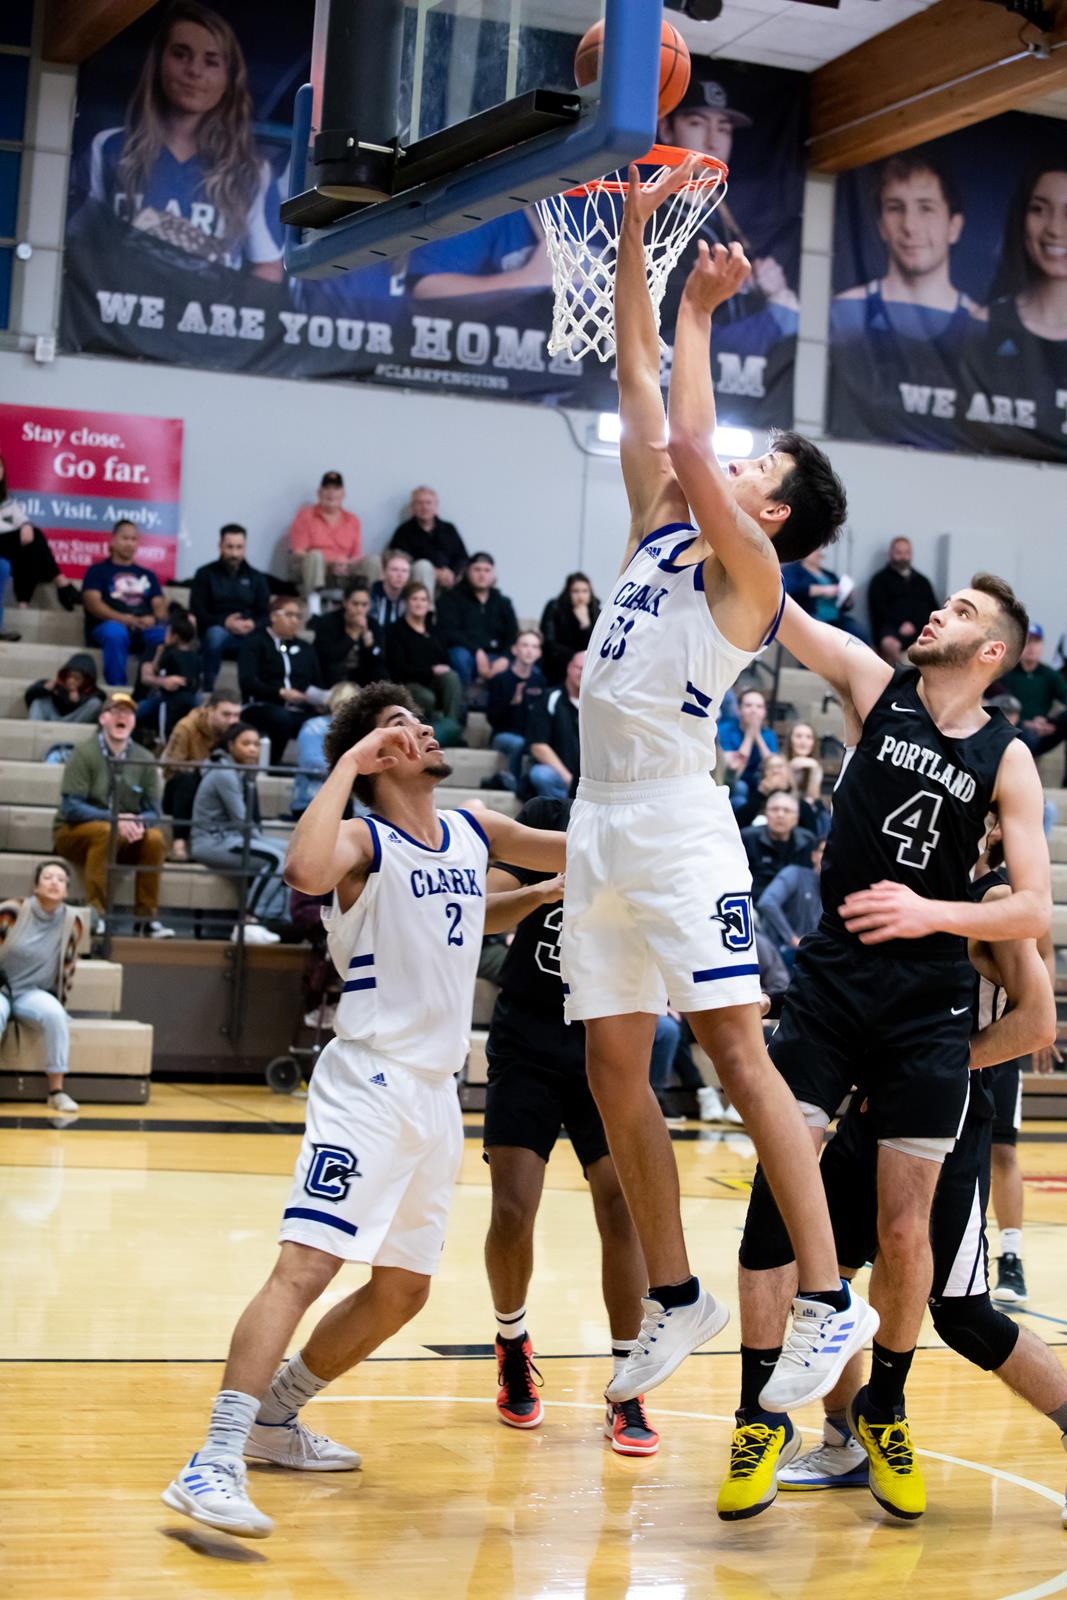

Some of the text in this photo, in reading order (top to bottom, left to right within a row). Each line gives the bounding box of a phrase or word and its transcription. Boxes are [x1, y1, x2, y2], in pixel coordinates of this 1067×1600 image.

[114, 192, 225, 239] CAR
[97, 291, 165, 329] WE
[177, 301, 265, 340] ARE
[279, 311, 394, 355] YOUR
[410, 315, 583, 376] HOME
[899, 383, 957, 419] WE
[965, 392, 1036, 429] ARE
[22, 422, 125, 449] Stay close.
[54, 452, 150, 484] Go far.
[20, 497, 45, 516] all.
[51, 500, 98, 520] Visit.
[876, 735, 976, 803] PORTLAND
[882, 790, 943, 870] 4
[411, 868, 482, 898] CLARK
[446, 902, 464, 947] 2
